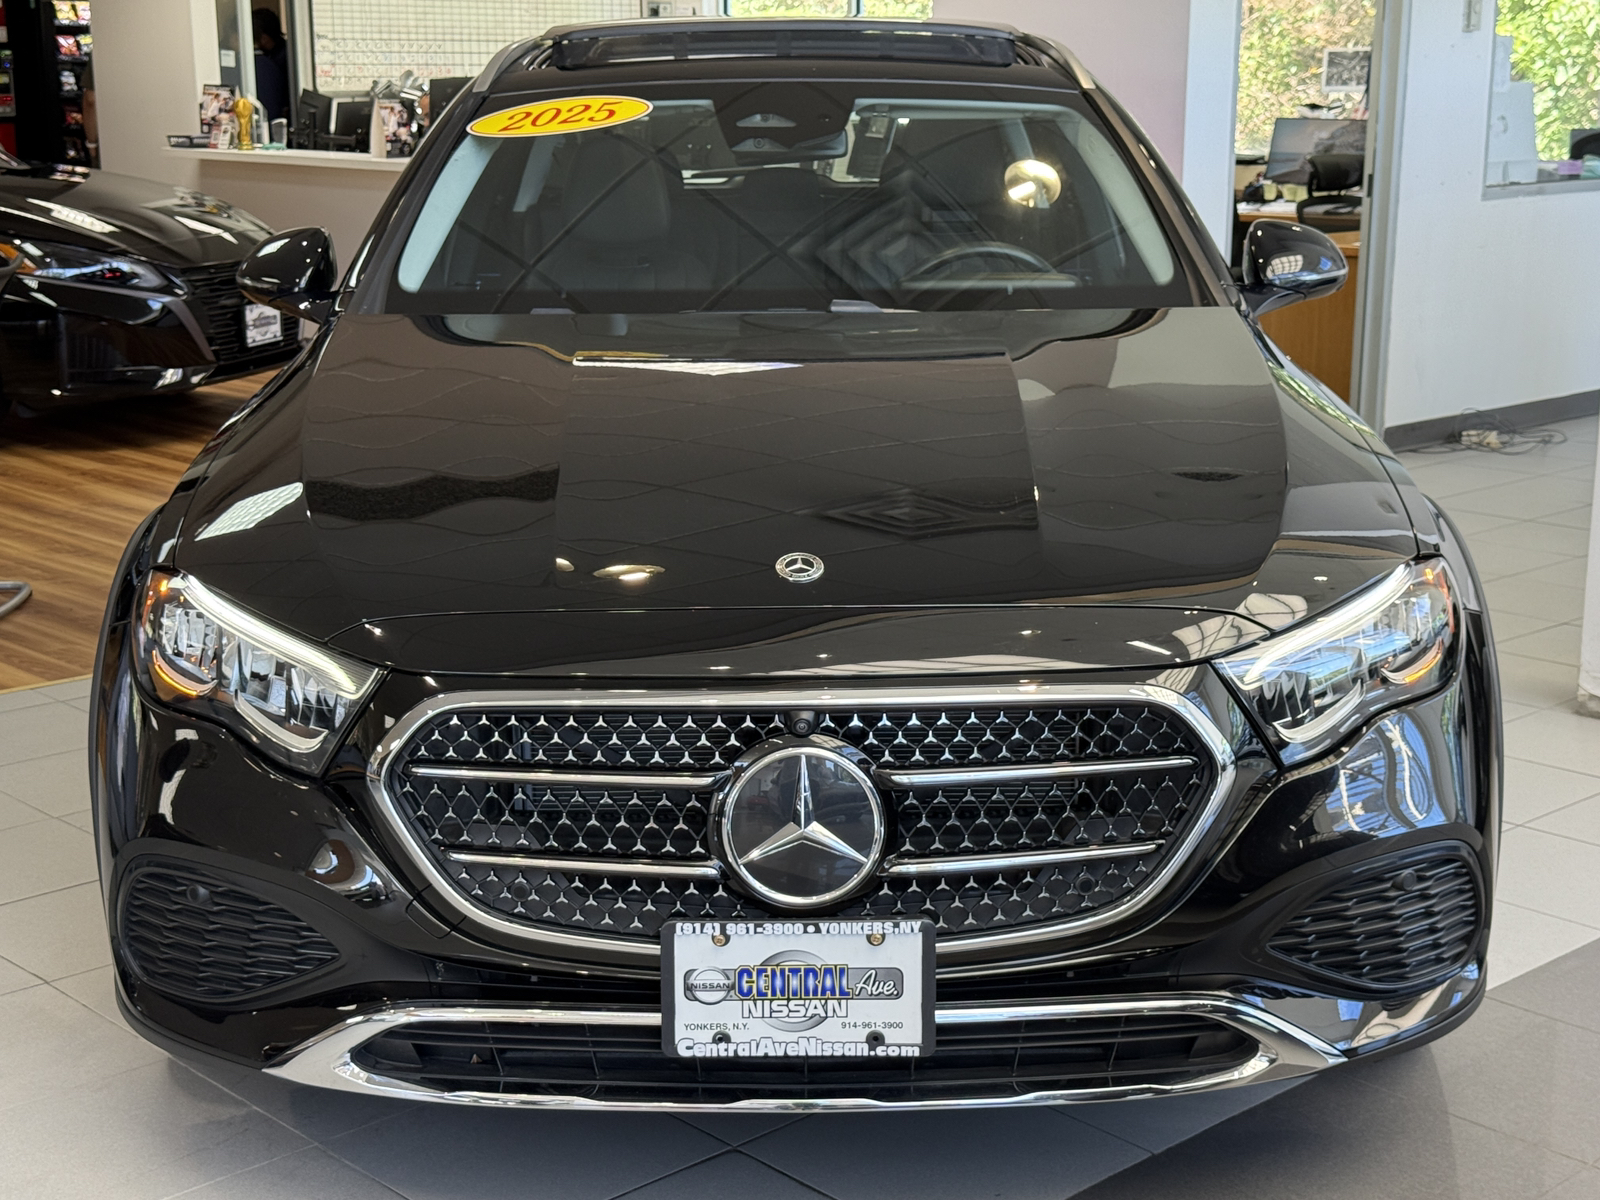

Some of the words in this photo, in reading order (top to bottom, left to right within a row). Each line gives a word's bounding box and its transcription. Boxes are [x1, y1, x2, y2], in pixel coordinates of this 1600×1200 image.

[498, 101, 623, 132] 2025
[725, 922, 804, 936] 961-3900
[690, 981, 730, 990] NISSAN
[735, 963, 853, 1000] CENTRAL
[855, 968, 899, 997] Ave.
[742, 999, 848, 1018] NISSAN
[683, 1022, 731, 1032] YONKERS,
[732, 1021, 750, 1031] N.Y.
[840, 1021, 904, 1030] 914-961-3900
[677, 1036, 920, 1058] CentralAveNissan.com
